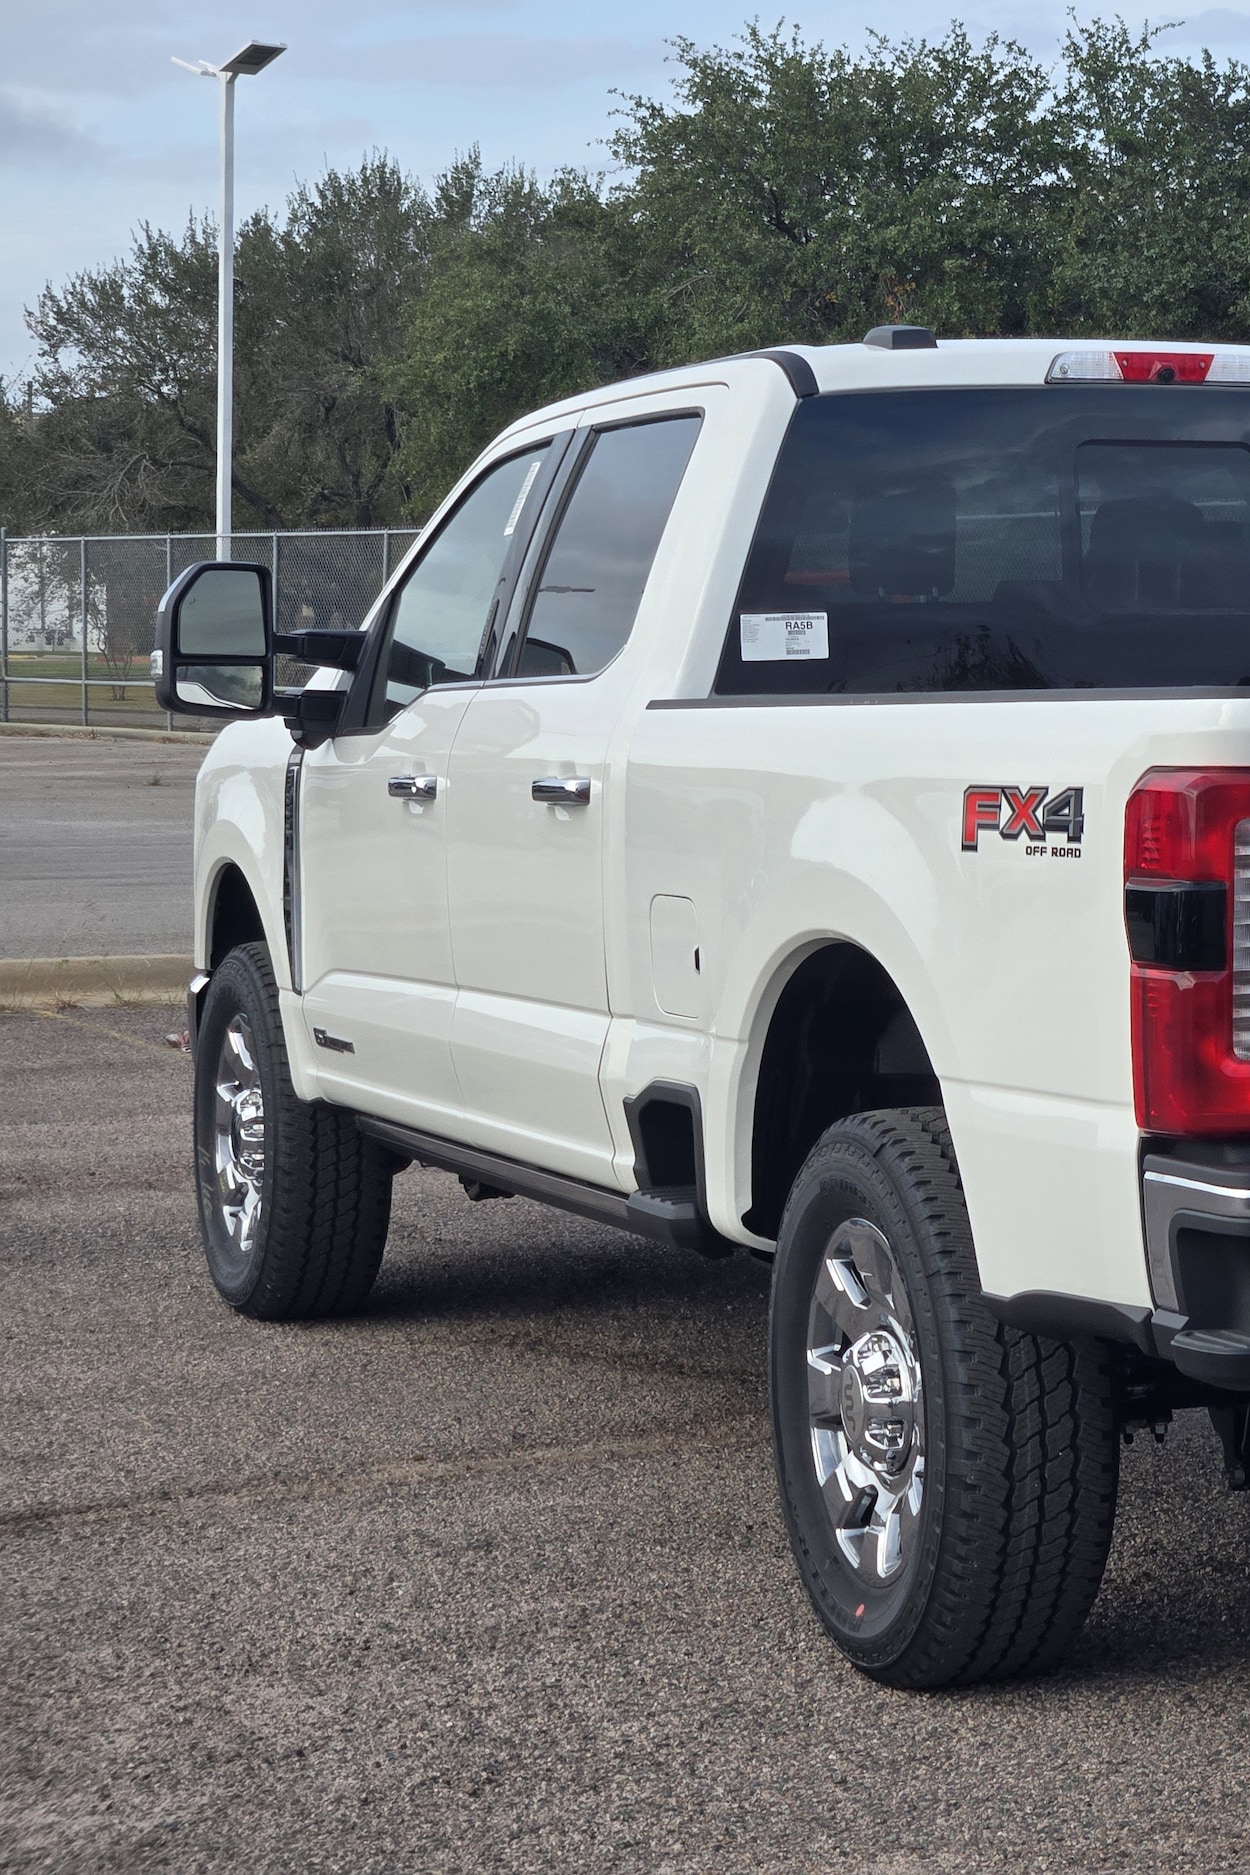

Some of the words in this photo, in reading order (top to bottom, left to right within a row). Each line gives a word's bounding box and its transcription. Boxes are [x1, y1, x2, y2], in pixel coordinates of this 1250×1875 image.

[785, 621, 813, 630] RA5B
[961, 785, 1085, 851] FX4
[1025, 846, 1048, 857] OFF
[1051, 847, 1081, 858] ROAD
